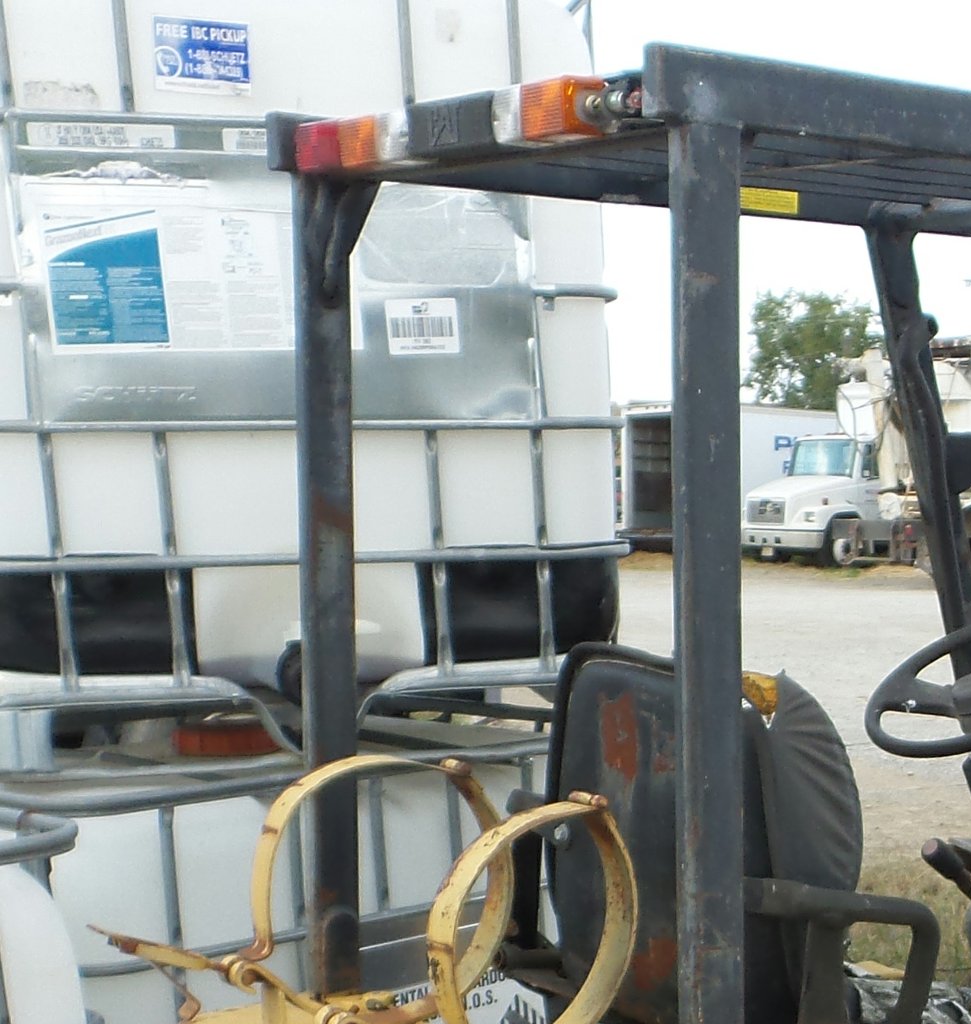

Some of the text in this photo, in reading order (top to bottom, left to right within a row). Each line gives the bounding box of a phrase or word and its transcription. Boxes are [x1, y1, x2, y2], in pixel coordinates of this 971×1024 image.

[156, 23, 247, 43] FREE IBC PICKUP
